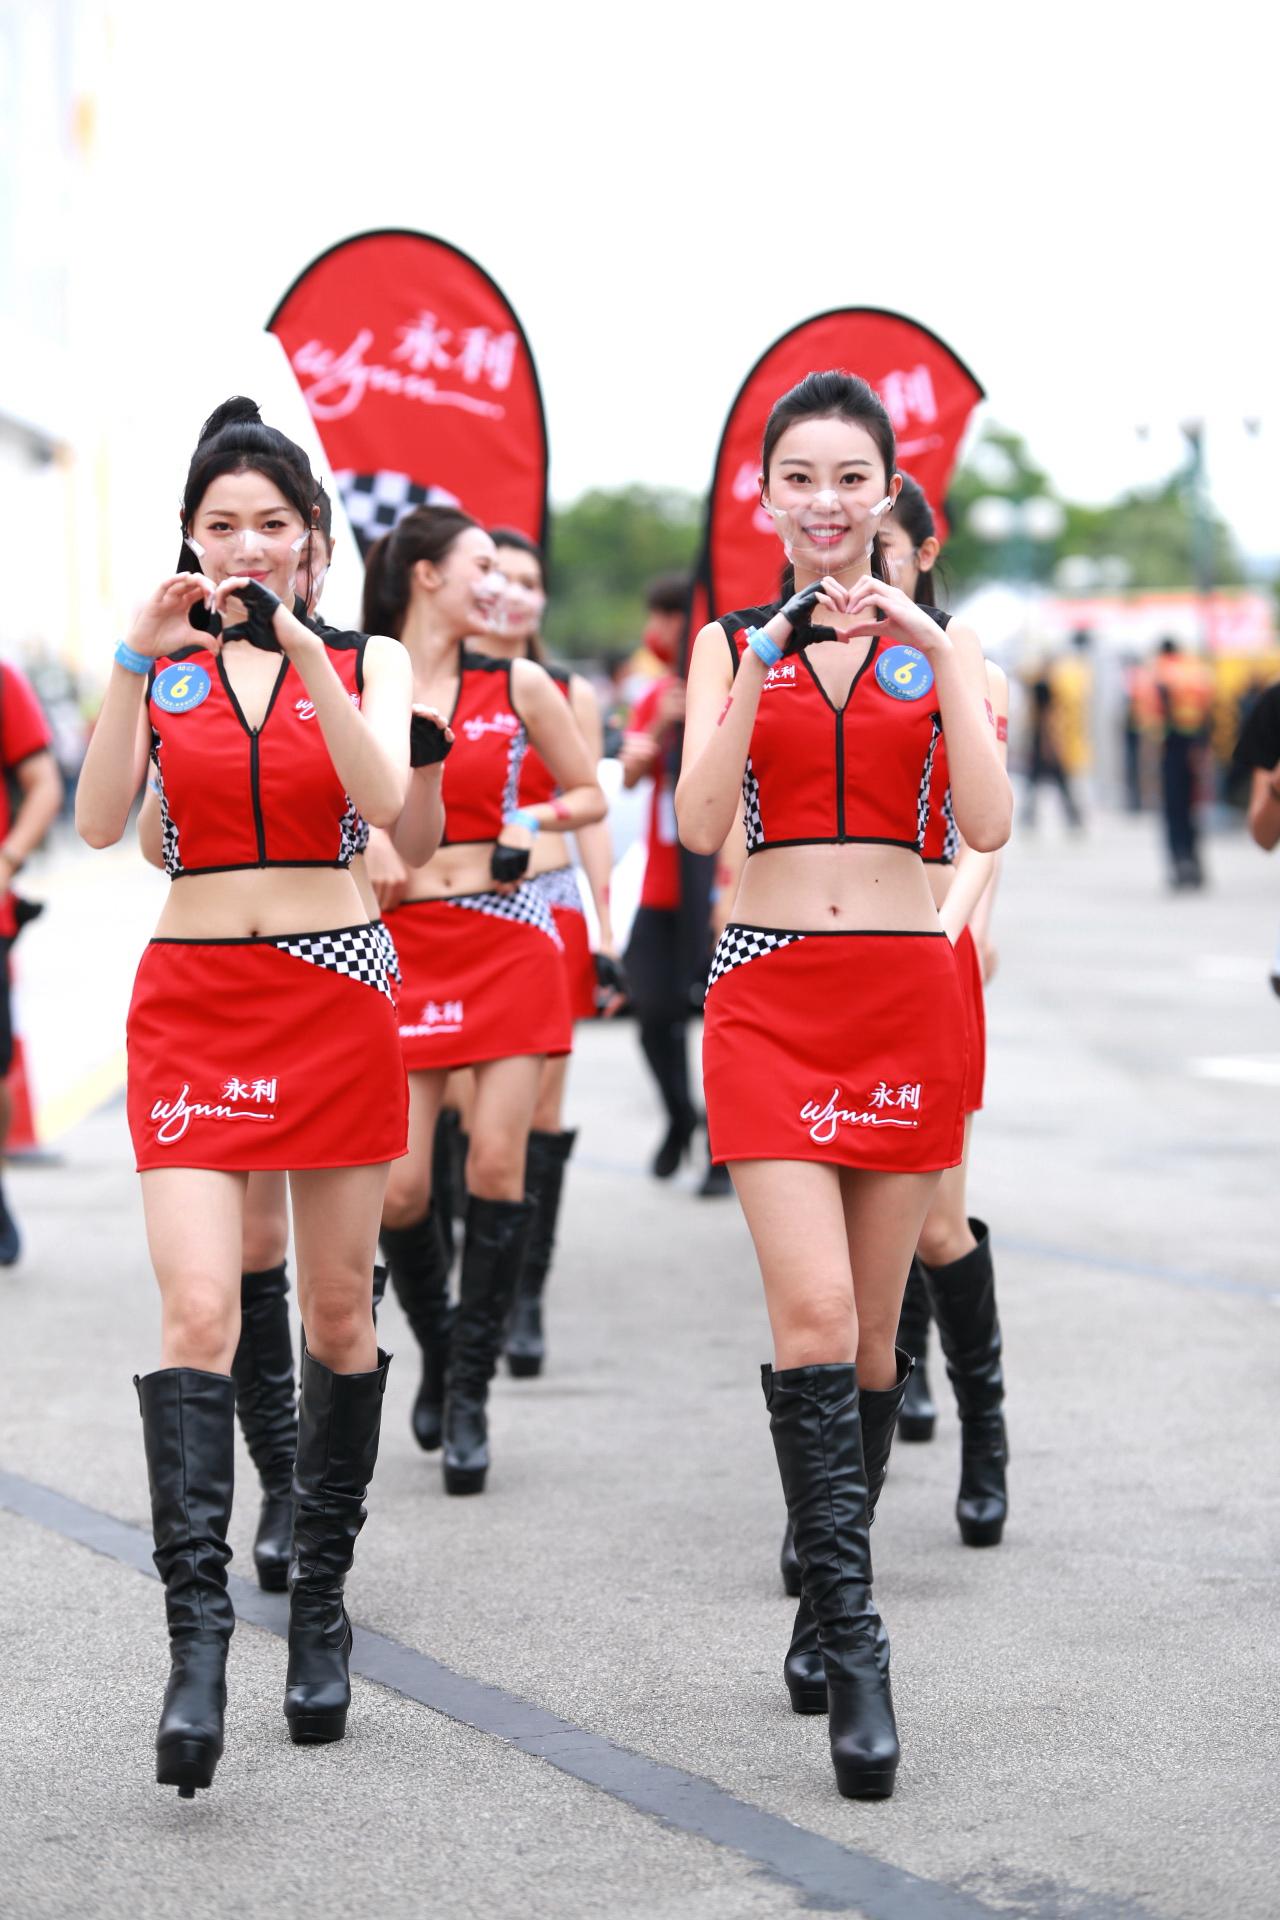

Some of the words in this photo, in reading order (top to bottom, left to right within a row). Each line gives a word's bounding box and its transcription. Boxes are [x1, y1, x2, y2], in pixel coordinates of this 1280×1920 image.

[765, 665, 796, 681] 永利
[894, 662, 917, 684] 6
[170, 674, 193, 698] 6
[222, 1077, 277, 1103] 永利
[868, 1081, 921, 1110] 永利
